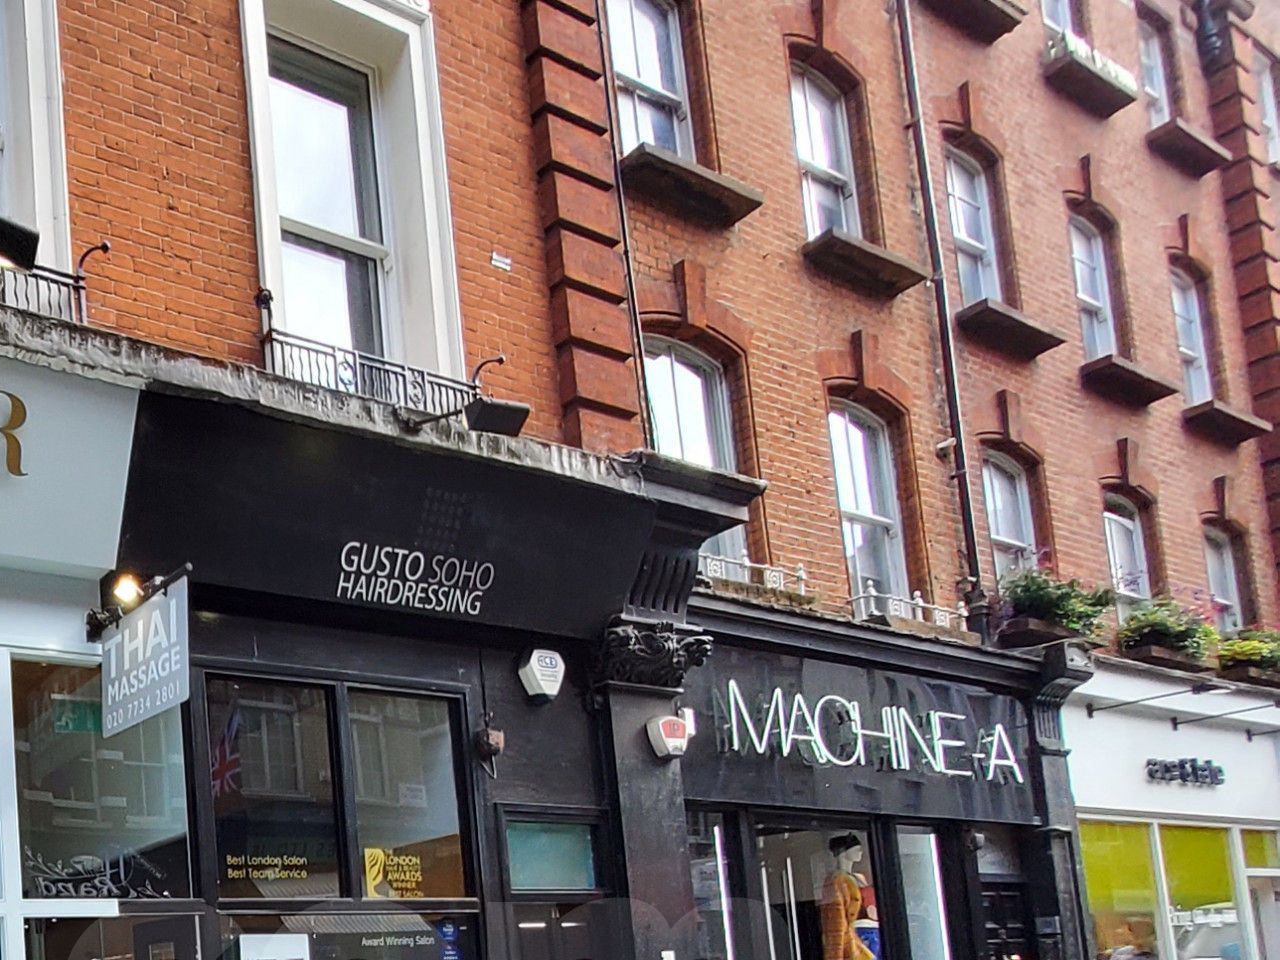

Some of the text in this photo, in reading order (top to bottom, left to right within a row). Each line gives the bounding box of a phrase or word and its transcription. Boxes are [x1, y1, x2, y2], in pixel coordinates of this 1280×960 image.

[340, 541, 495, 590] GUSTO SOHO
[336, 572, 483, 615] HAIRDRESSING
[104, 598, 177, 679] THAI
[107, 645, 181, 706] MASSAGE
[106, 680, 180, 729] 020 7734 2801
[226, 854, 245, 865] Best
[283, 854, 308, 865] Salon
[227, 867, 246, 879] Best
[275, 867, 308, 879] Service
[385, 855, 421, 866] LONDON
[387, 871, 422, 881] AWARDS
[361, 935, 435, 947] Award Winning Salon
